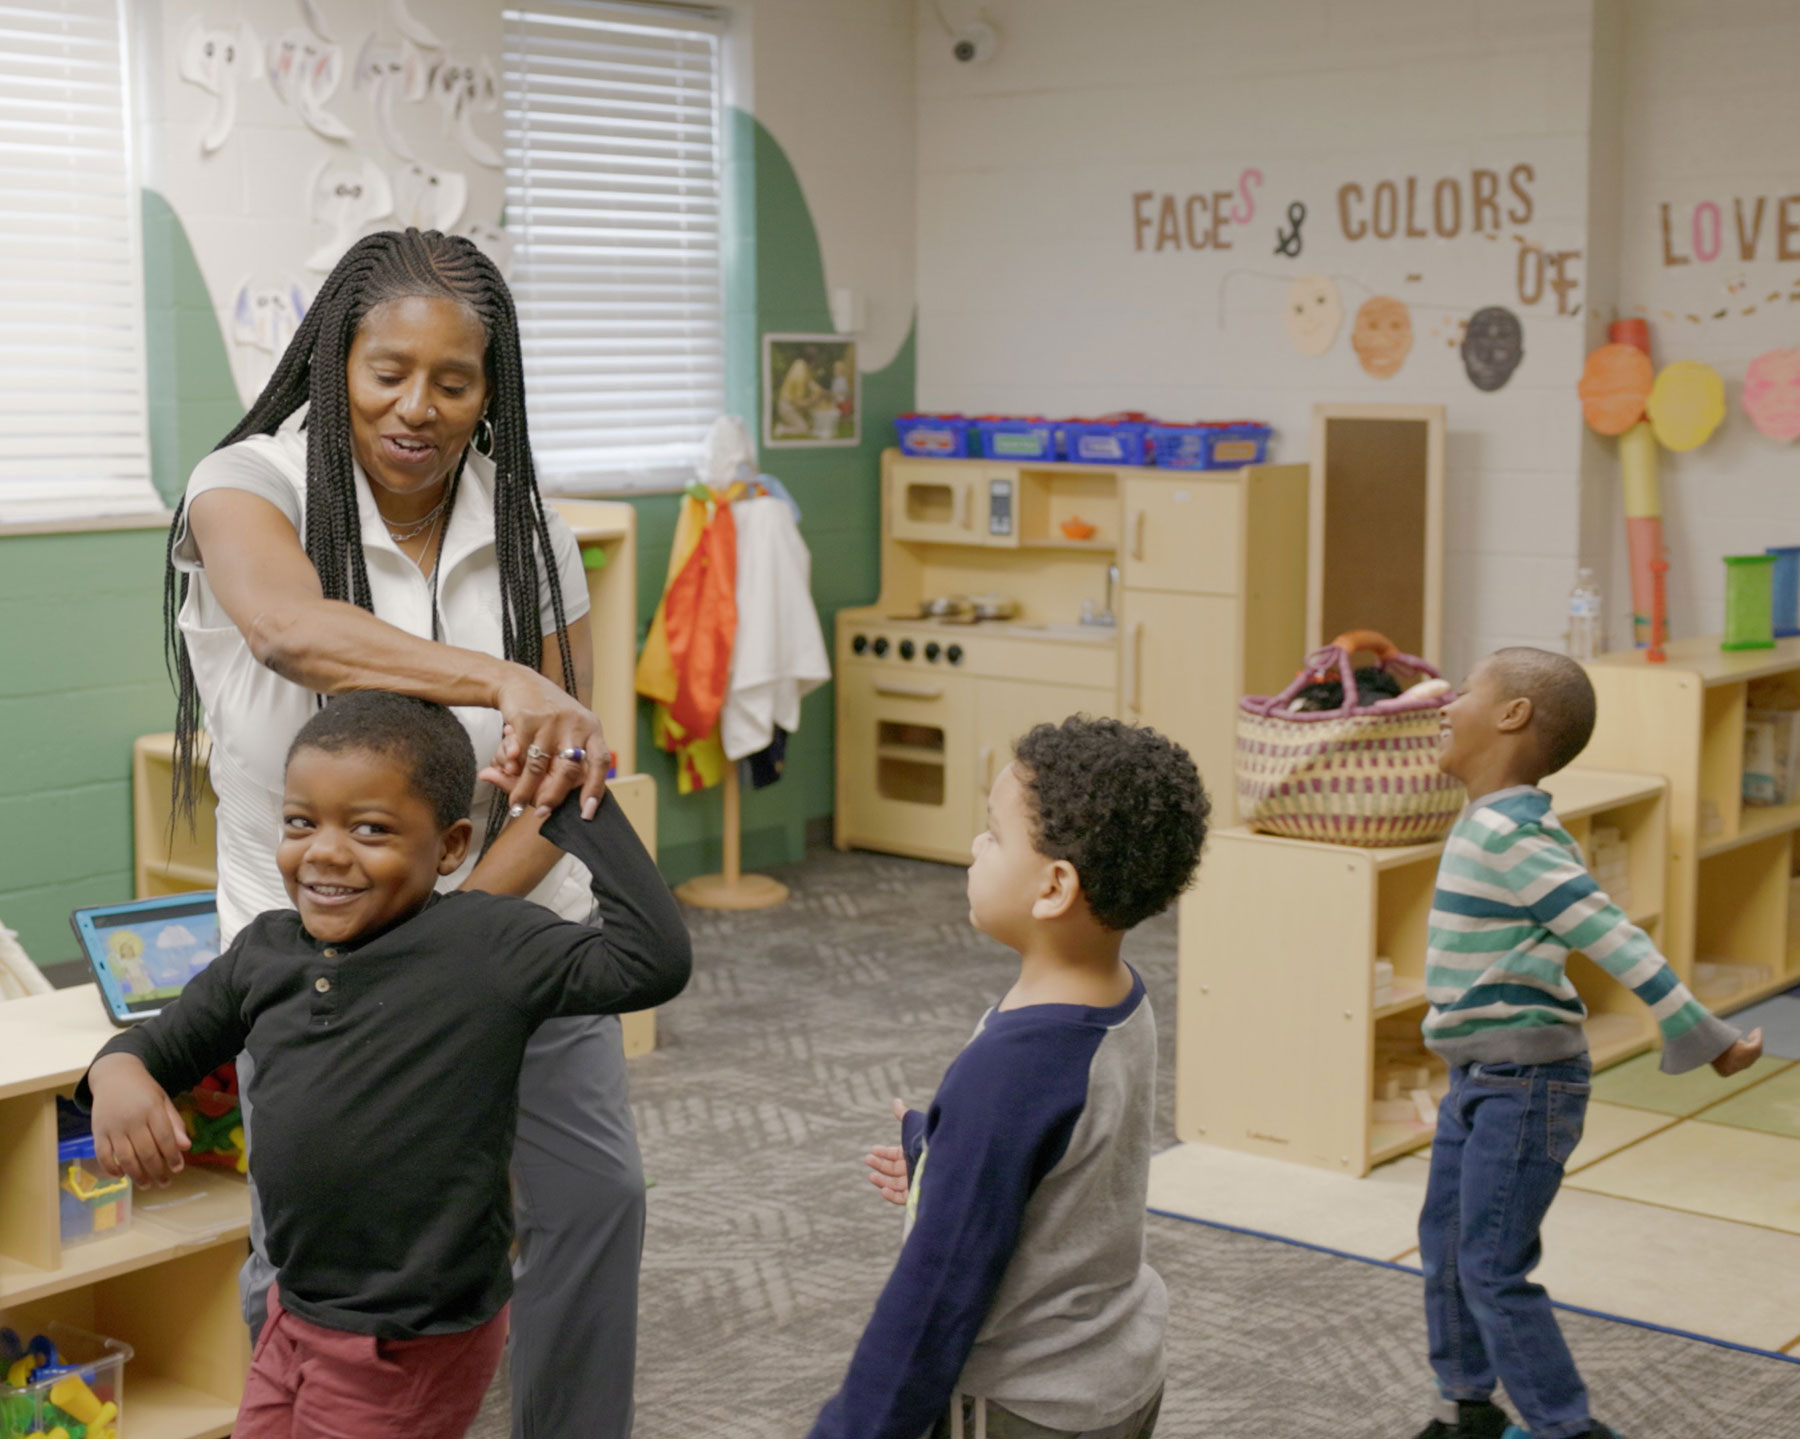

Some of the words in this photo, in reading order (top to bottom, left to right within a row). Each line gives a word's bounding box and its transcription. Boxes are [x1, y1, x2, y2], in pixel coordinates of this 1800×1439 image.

[1133, 168, 1263, 251] FACES
[1273, 201, 1306, 257] &
[1338, 164, 1534, 240] COLORS
[1661, 195, 1800, 266] LOVE
[1517, 244, 1582, 314] OF
